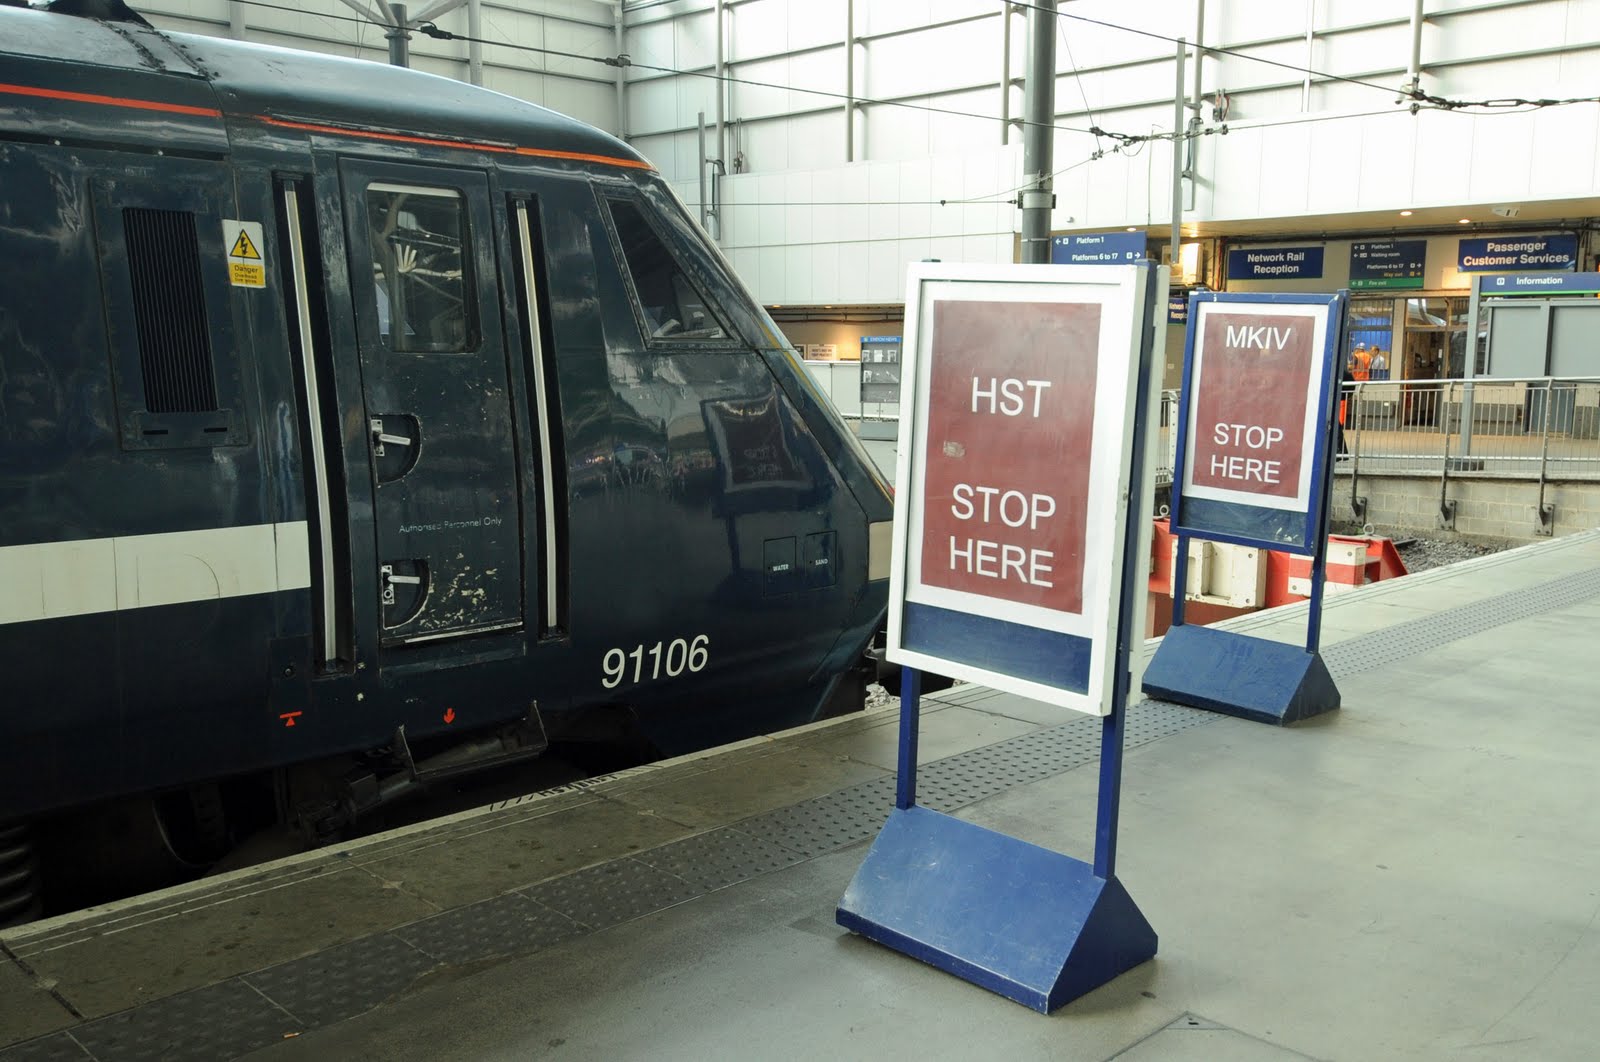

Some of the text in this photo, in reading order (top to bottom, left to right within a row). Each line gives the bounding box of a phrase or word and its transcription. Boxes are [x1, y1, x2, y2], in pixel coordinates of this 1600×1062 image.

[1487, 242, 1546, 253] Passenger
[1247, 252, 1305, 262] Network Rail
[1463, 254, 1570, 266] Customer Services
[235, 265, 258, 274] Danger
[1253, 265, 1299, 275] Reception
[1516, 277, 1563, 285] Information
[1226, 325, 1291, 350] MKIV
[972, 376, 1051, 417] HST
[1213, 422, 1283, 450] STOP
[1210, 454, 1281, 484] HERE
[951, 483, 1056, 530] STOP
[483, 516, 502, 527] Only
[815, 558, 828, 566] SAND
[950, 535, 1054, 588] HERE
[772, 564, 789, 572] WATER
[602, 634, 709, 689] 91106
